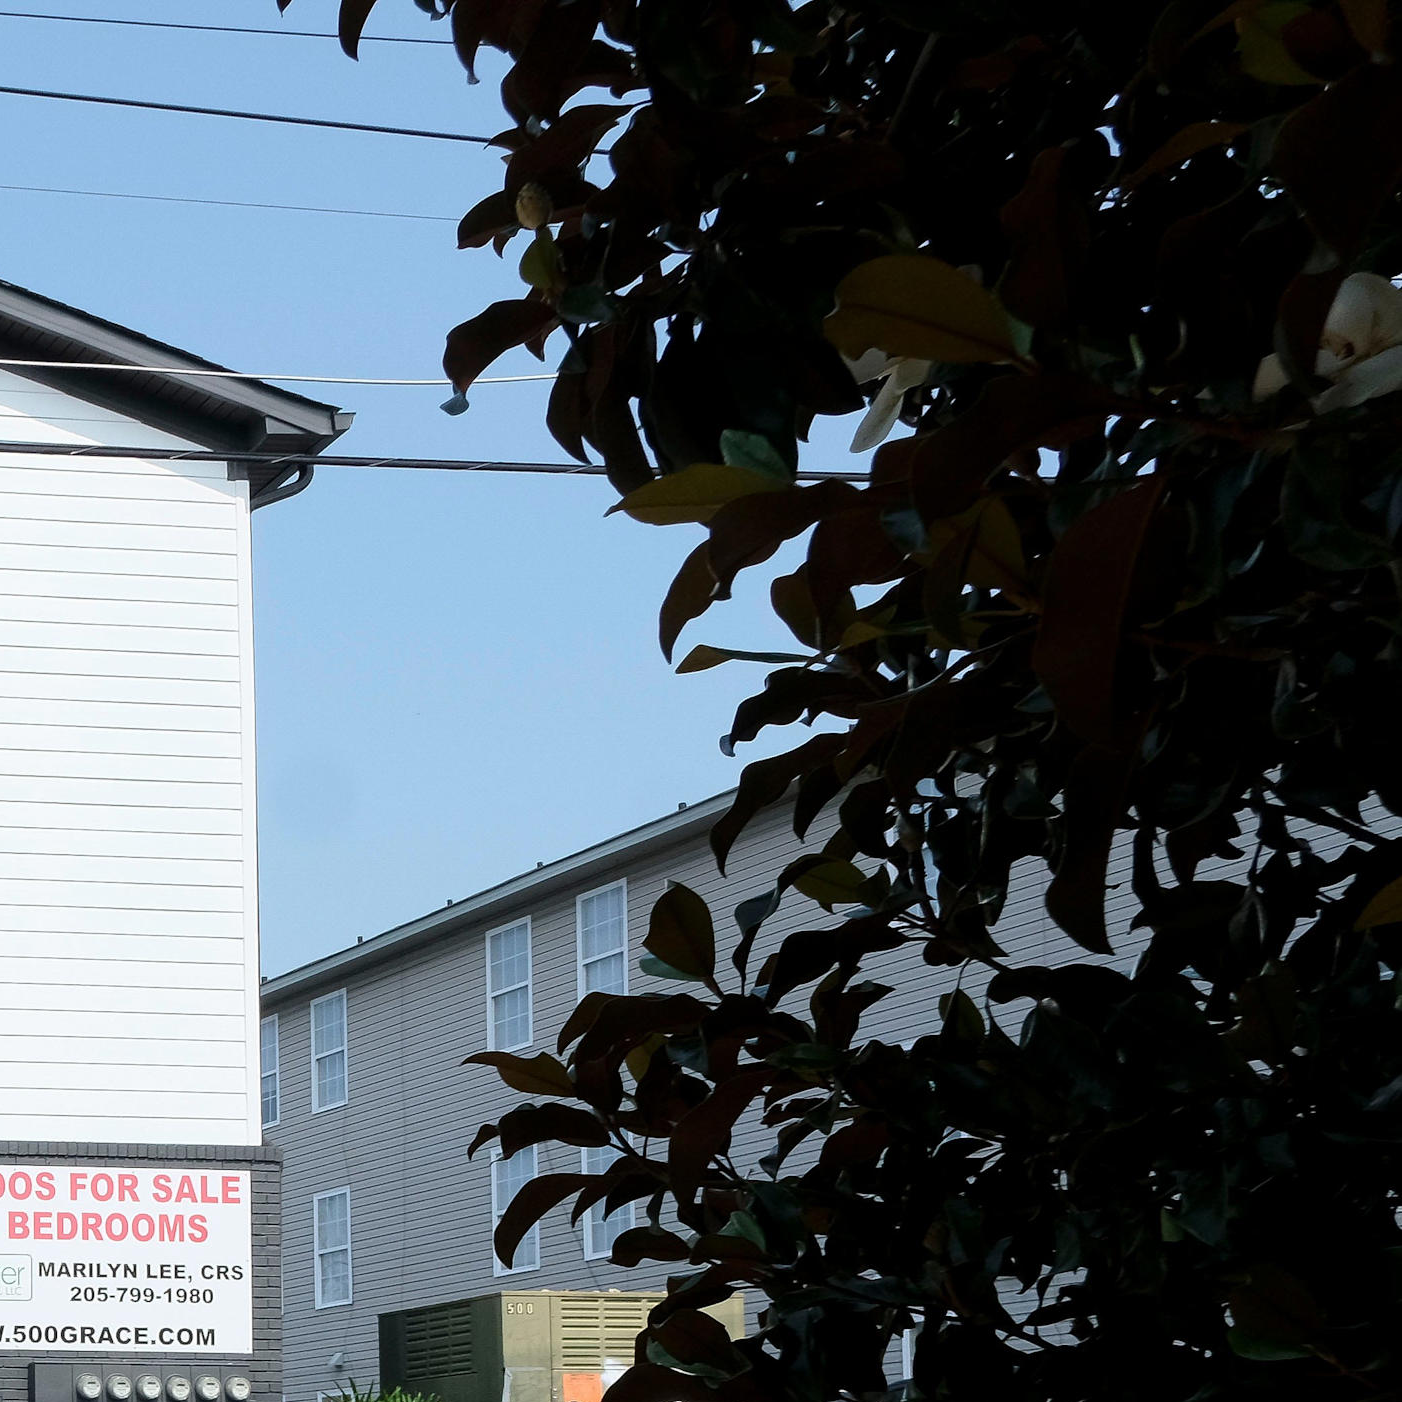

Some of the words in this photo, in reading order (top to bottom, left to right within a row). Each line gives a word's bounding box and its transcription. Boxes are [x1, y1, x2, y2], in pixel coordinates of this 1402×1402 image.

[69, 1172, 141, 1203] FOR
[152, 1174, 241, 1204] SALE
[8, 1211, 209, 1243] BEDROOMS
[38, 1262, 138, 1279] MARILYN
[146, 1264, 193, 1283] LEE,
[201, 1265, 244, 1280] CRS
[70, 1286, 214, 1304] 205-799-1980
[507, 1302, 534, 1315] 500
